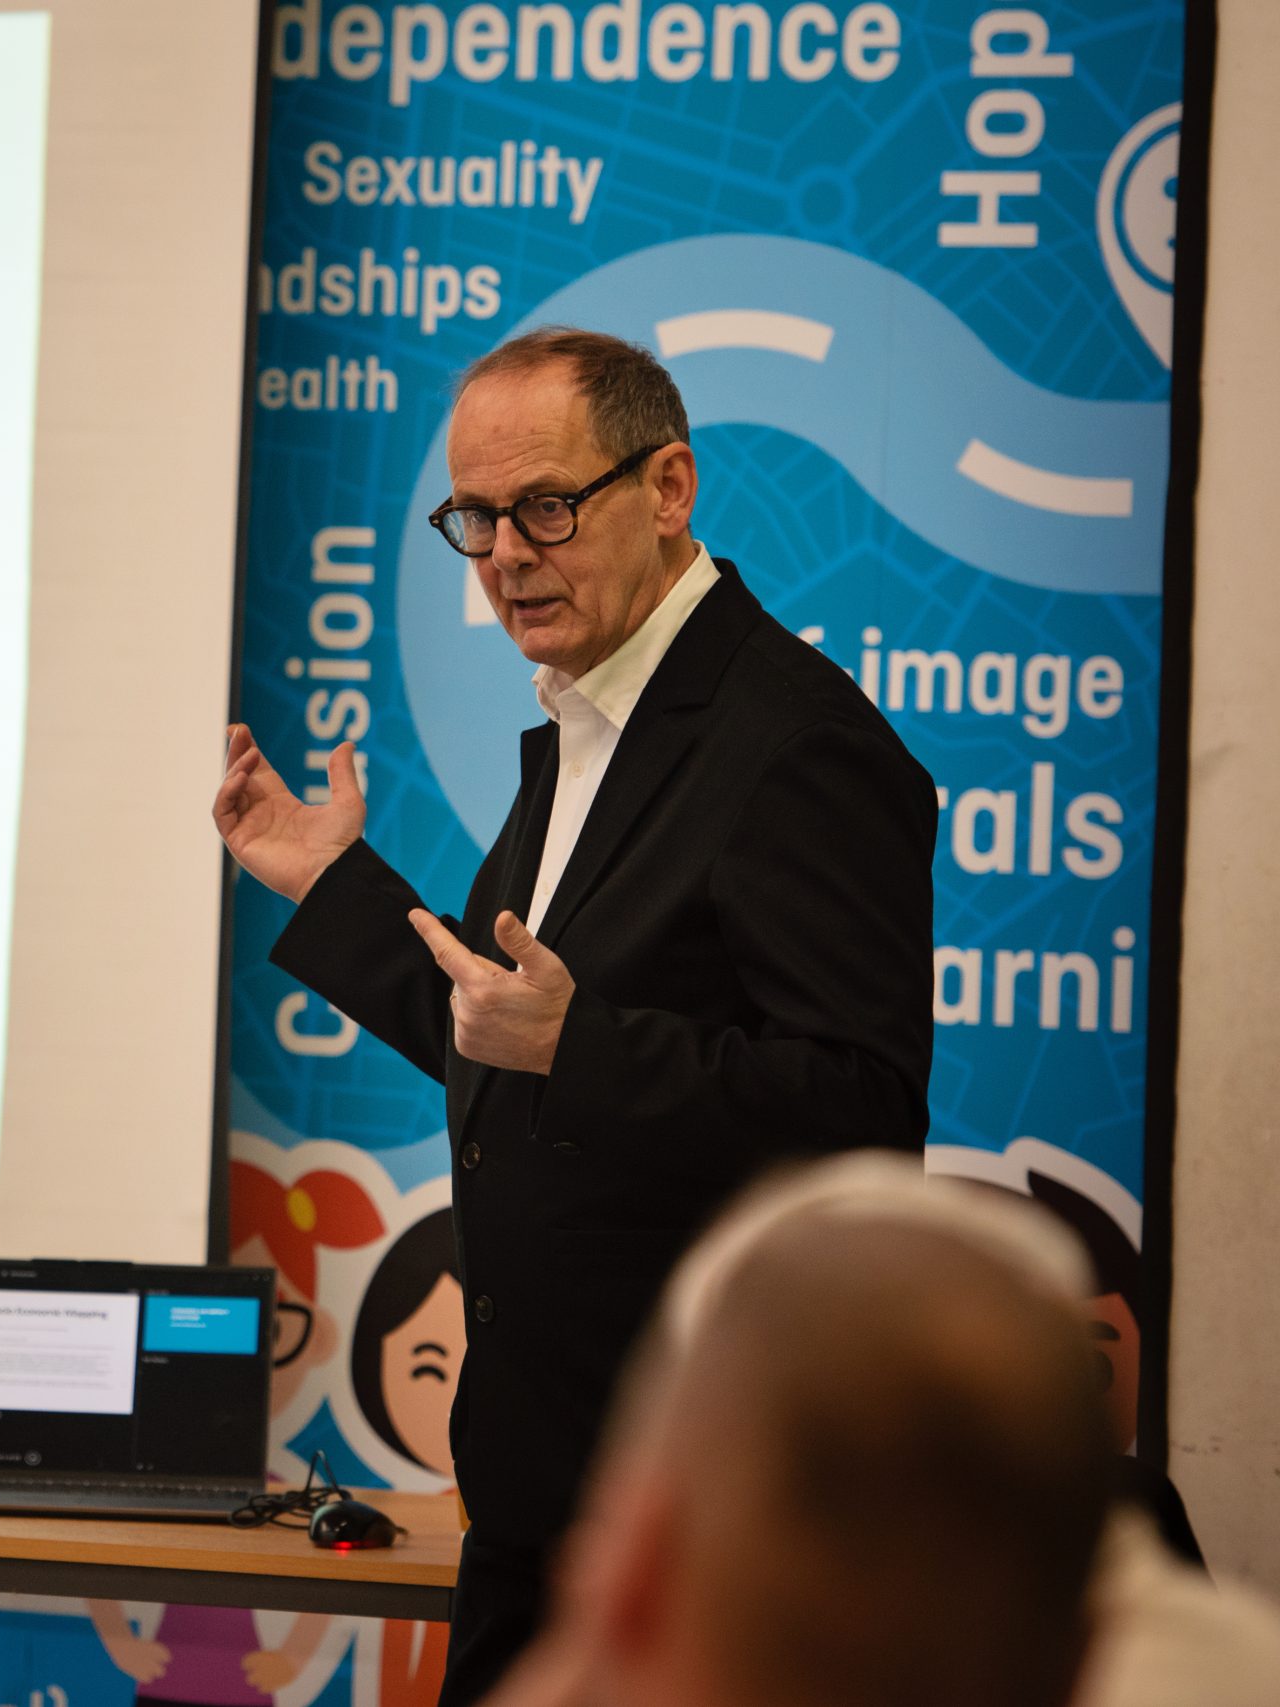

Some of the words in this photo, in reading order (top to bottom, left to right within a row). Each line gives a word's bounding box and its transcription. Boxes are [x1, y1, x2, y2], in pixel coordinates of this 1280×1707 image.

[270, 0, 902, 106] dependence
[303, 140, 604, 224] Sexuality
[937, 9, 1074, 248] Hop
[258, 355, 399, 412] ealth
[798, 626, 1124, 738] image
[935, 762, 1124, 880] als
